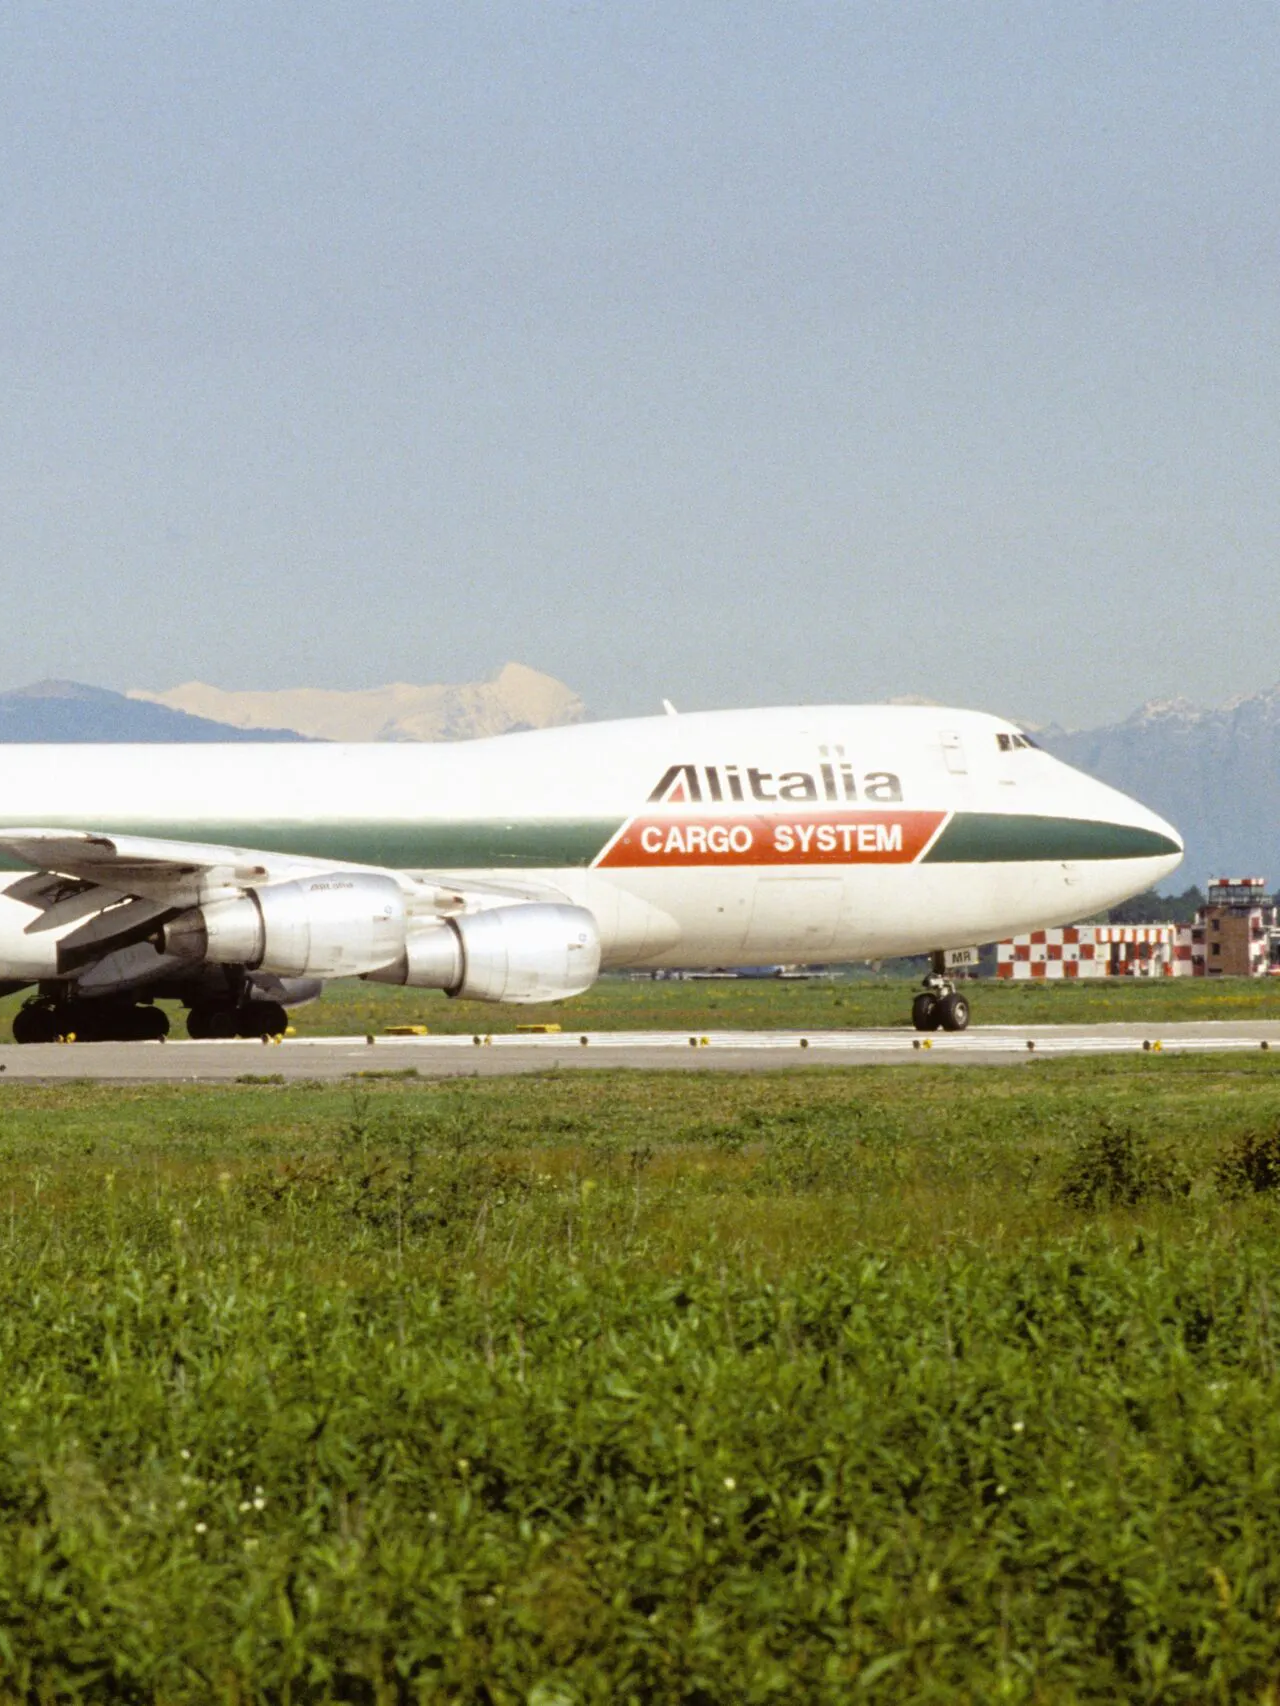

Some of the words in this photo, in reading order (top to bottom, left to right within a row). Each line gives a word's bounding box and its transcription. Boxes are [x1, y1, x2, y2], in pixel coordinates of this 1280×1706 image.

[646, 763, 904, 802] Alitalia
[640, 826, 753, 853] CARGO
[773, 824, 903, 852] SYSTEM
[951, 951, 971, 964] MR
